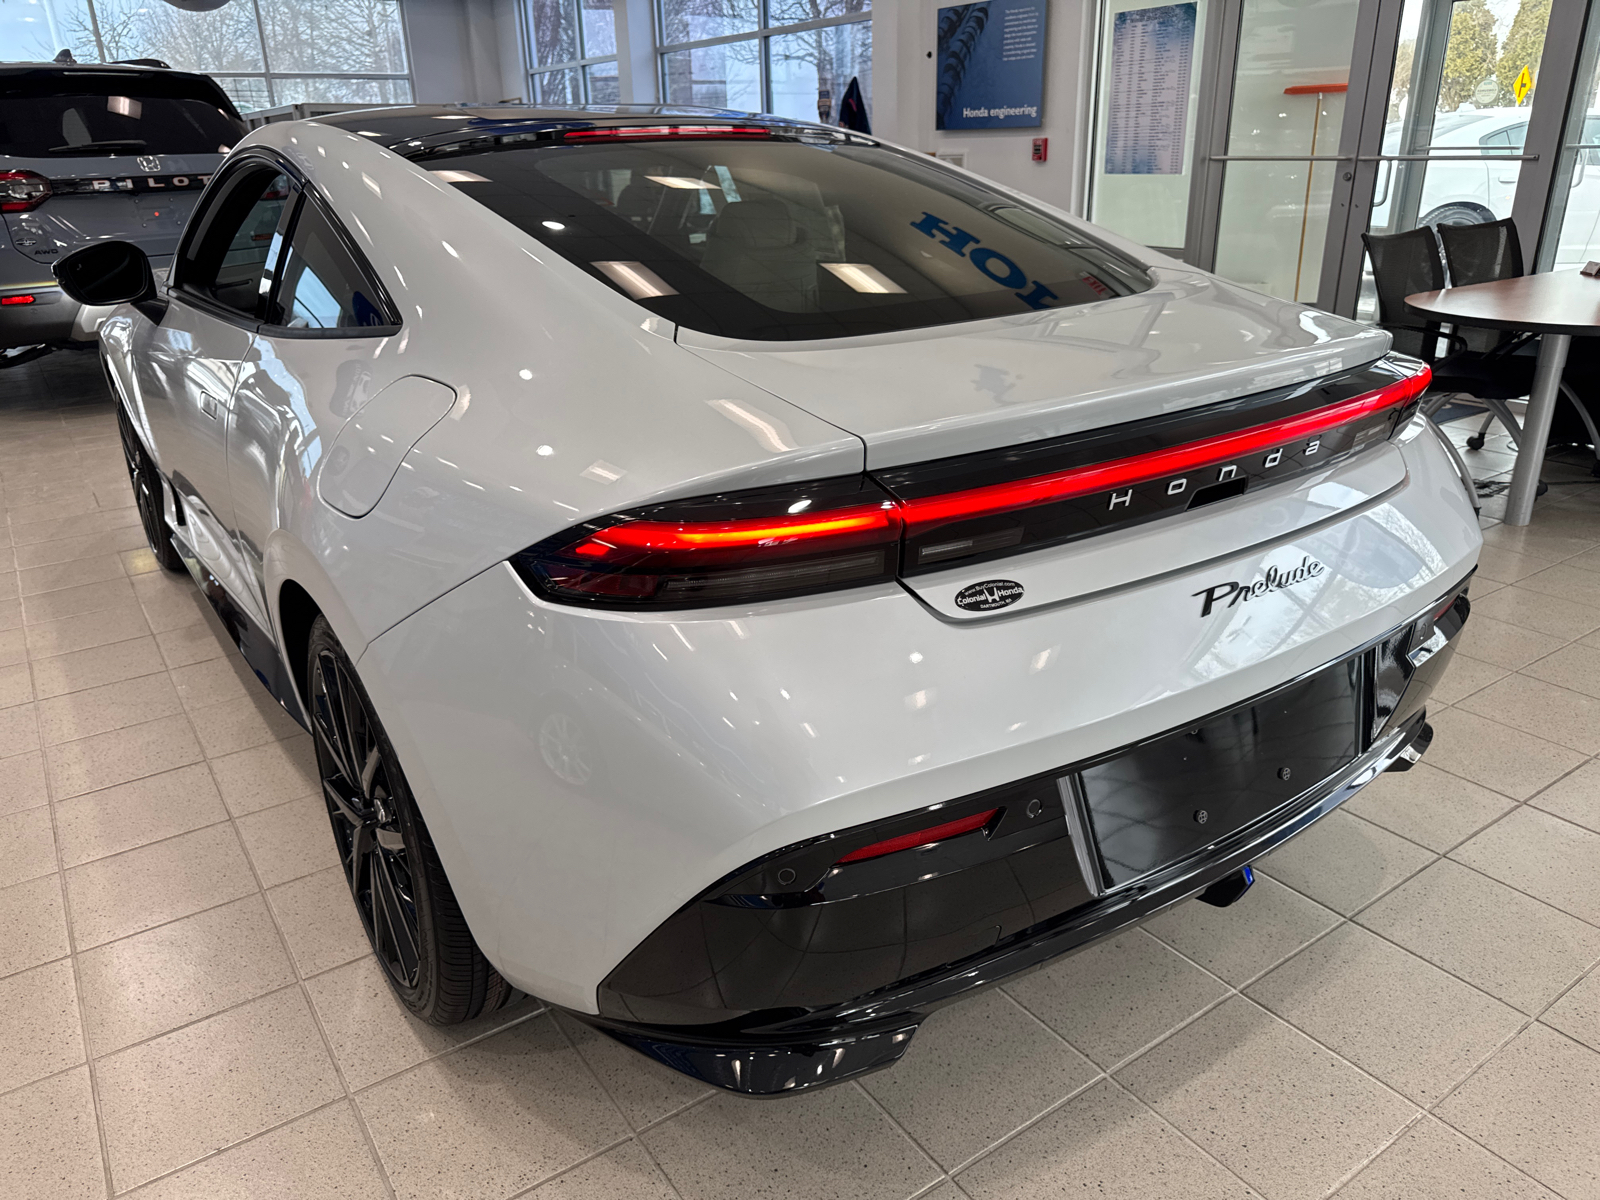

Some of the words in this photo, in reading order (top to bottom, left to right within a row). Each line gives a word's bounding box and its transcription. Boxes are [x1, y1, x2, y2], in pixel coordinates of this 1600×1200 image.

[963, 107, 988, 118] Honda
[990, 104, 1037, 119] engineering
[92, 175, 212, 190] PILOT
[1108, 440, 1320, 510] Honda
[957, 594, 986, 605] Colonial
[997, 586, 1024, 597] Honda
[1192, 555, 1325, 618] Prelude
